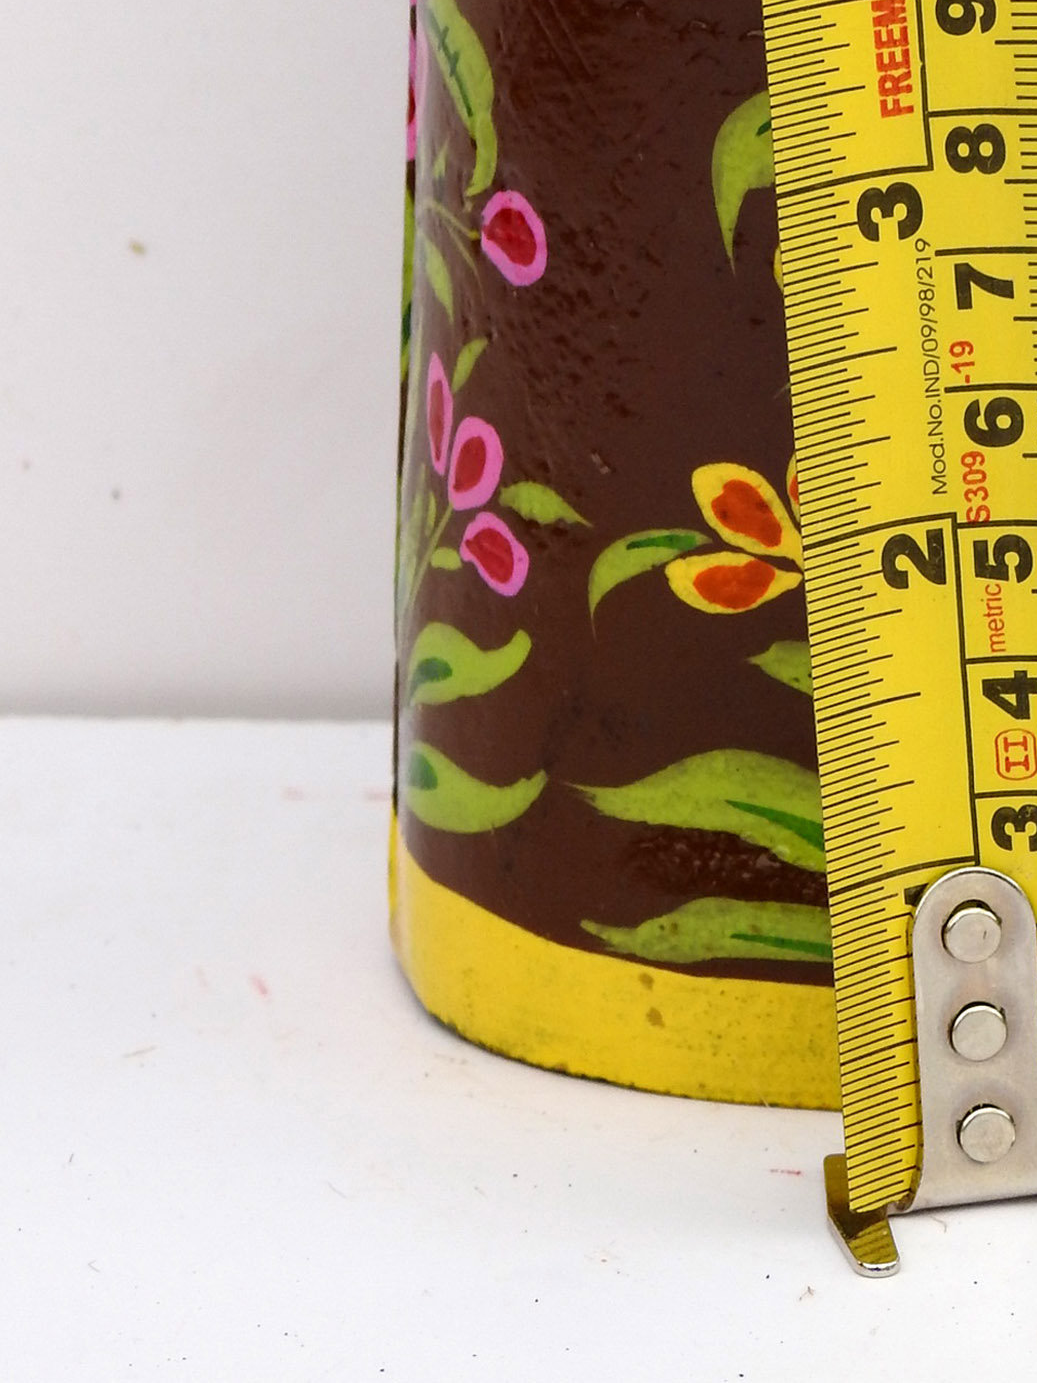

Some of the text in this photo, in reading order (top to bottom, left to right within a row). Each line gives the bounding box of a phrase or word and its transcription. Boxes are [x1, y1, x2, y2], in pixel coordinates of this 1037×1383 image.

[945, 123, 1006, 175] 8
[856, 182, 924, 242] 3
[954, 262, 1015, 310] 7
[963, 396, 1024, 448] 6
[881, 528, 947, 590] 2
[973, 534, 1034, 584] 5
[983, 583, 1007, 653] metric
